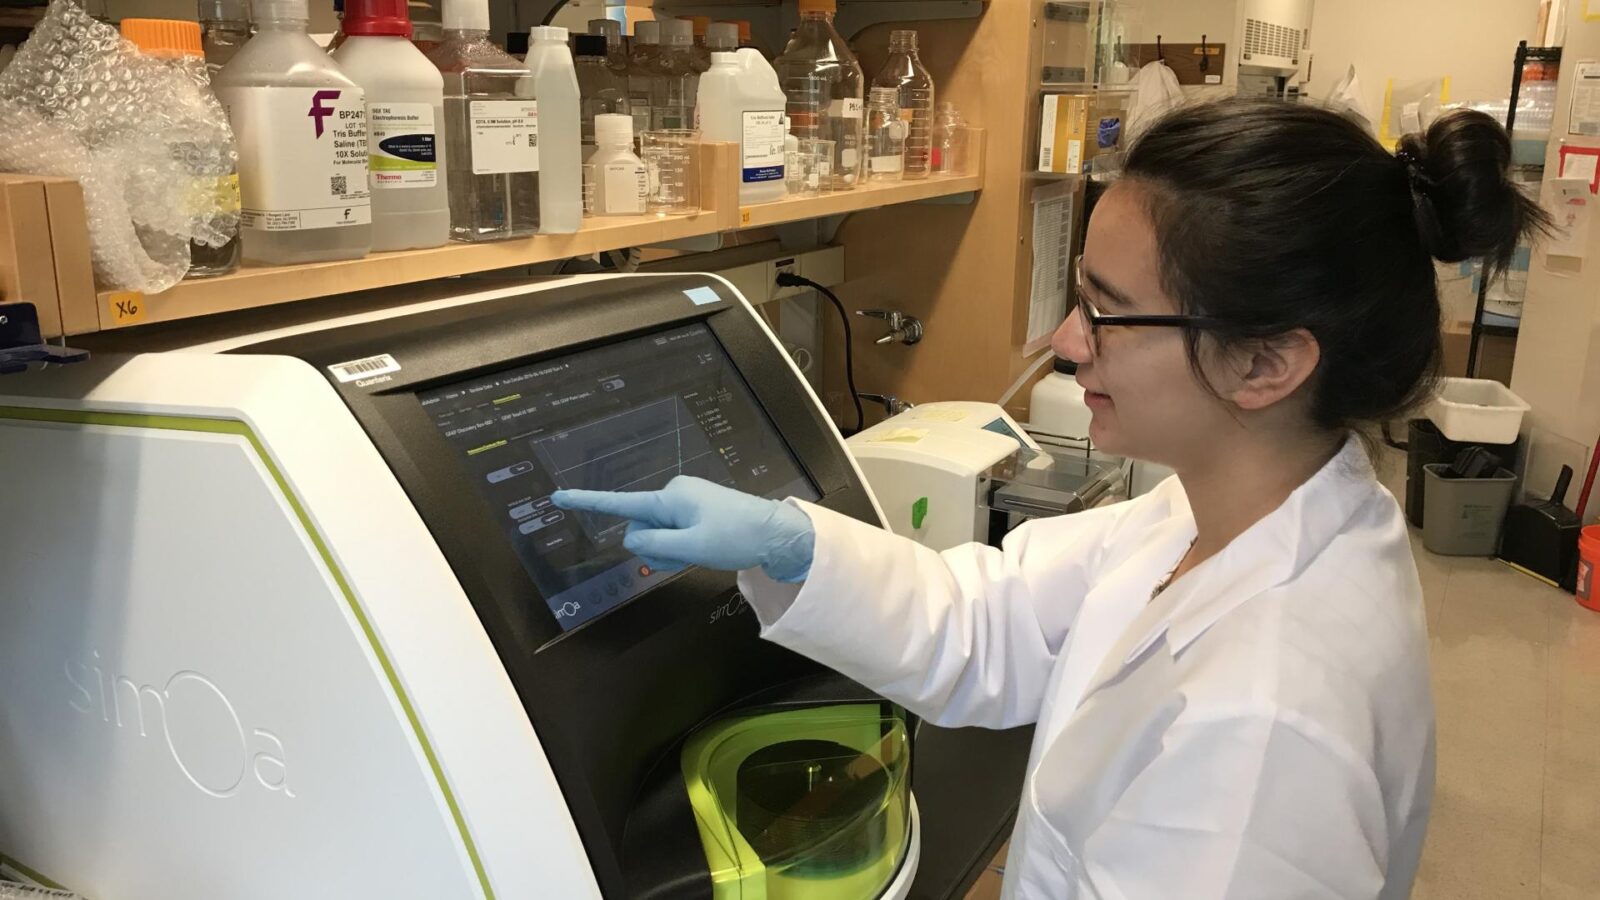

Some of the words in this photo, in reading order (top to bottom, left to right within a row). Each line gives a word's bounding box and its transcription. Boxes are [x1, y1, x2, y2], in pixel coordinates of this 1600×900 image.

[333, 129, 347, 138] Tris
[334, 140, 356, 149] Saline
[335, 150, 349, 158] 10X
[115, 299, 138, 319] X6
